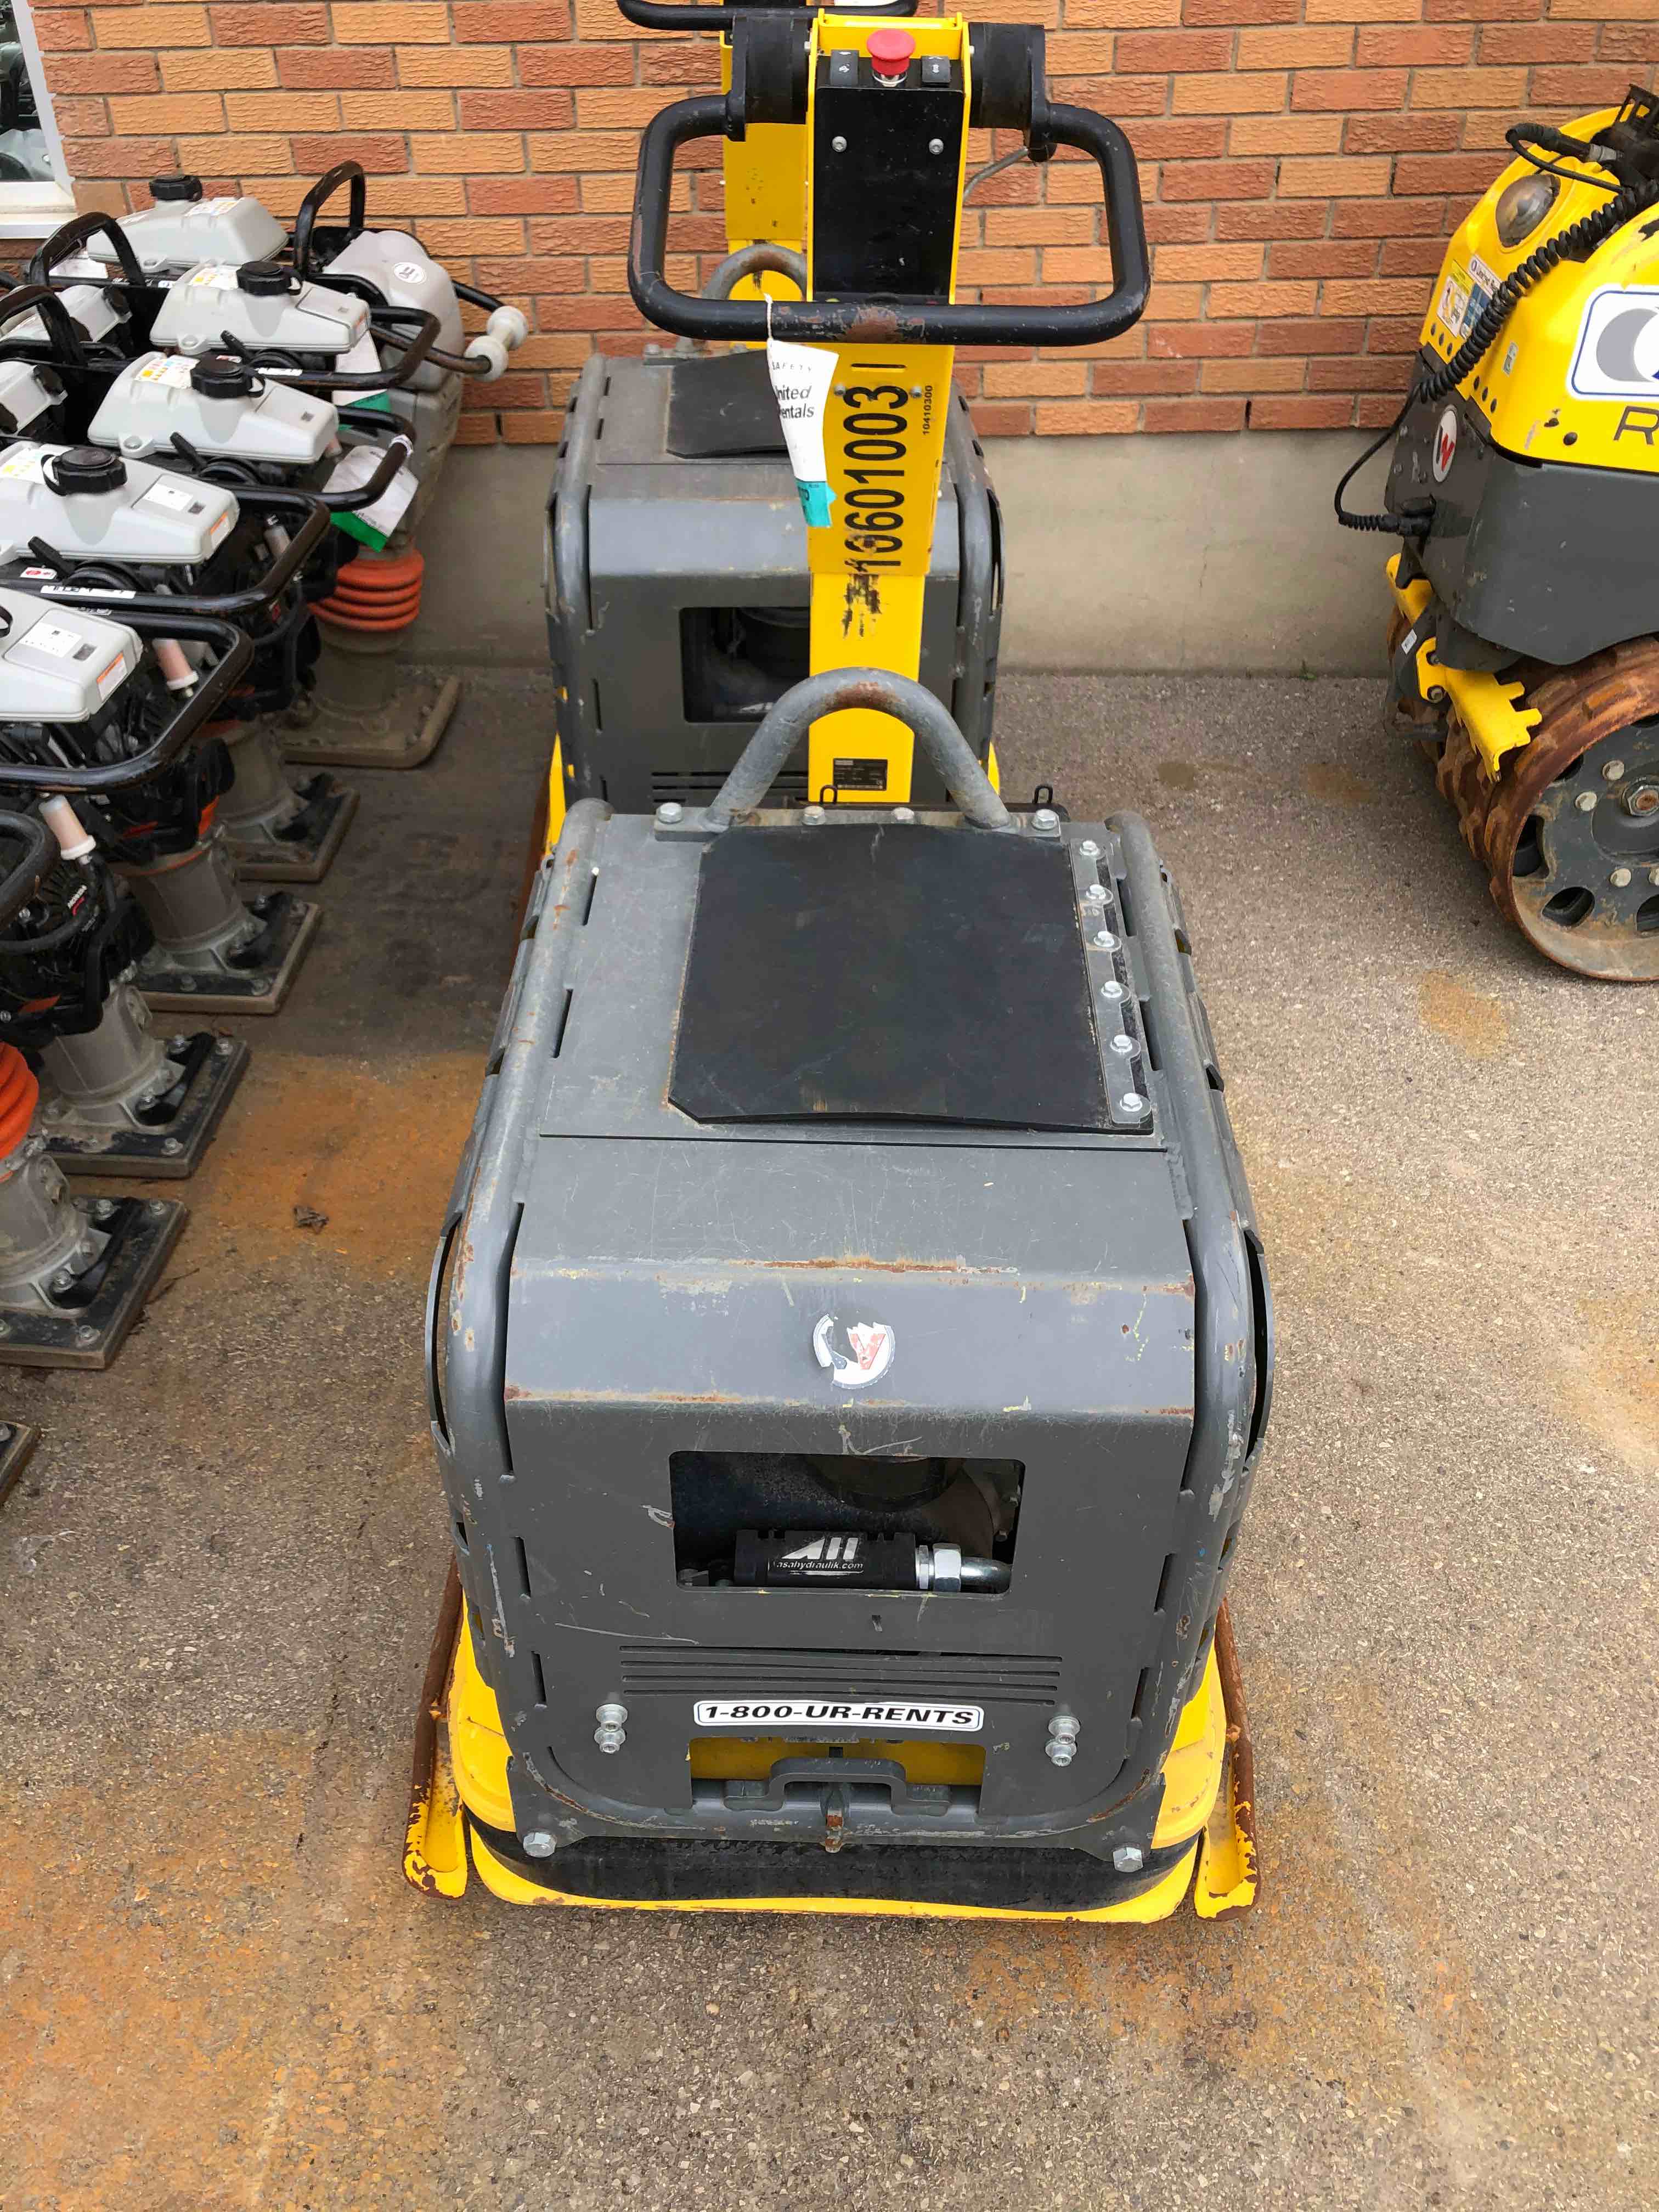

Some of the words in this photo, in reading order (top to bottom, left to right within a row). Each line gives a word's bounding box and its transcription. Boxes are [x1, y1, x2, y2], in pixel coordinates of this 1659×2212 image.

[922, 385, 933, 436] 10410300
[842, 385, 909, 567] 10601003
[704, 1705, 974, 1725] 1-800-UR-RENTS
